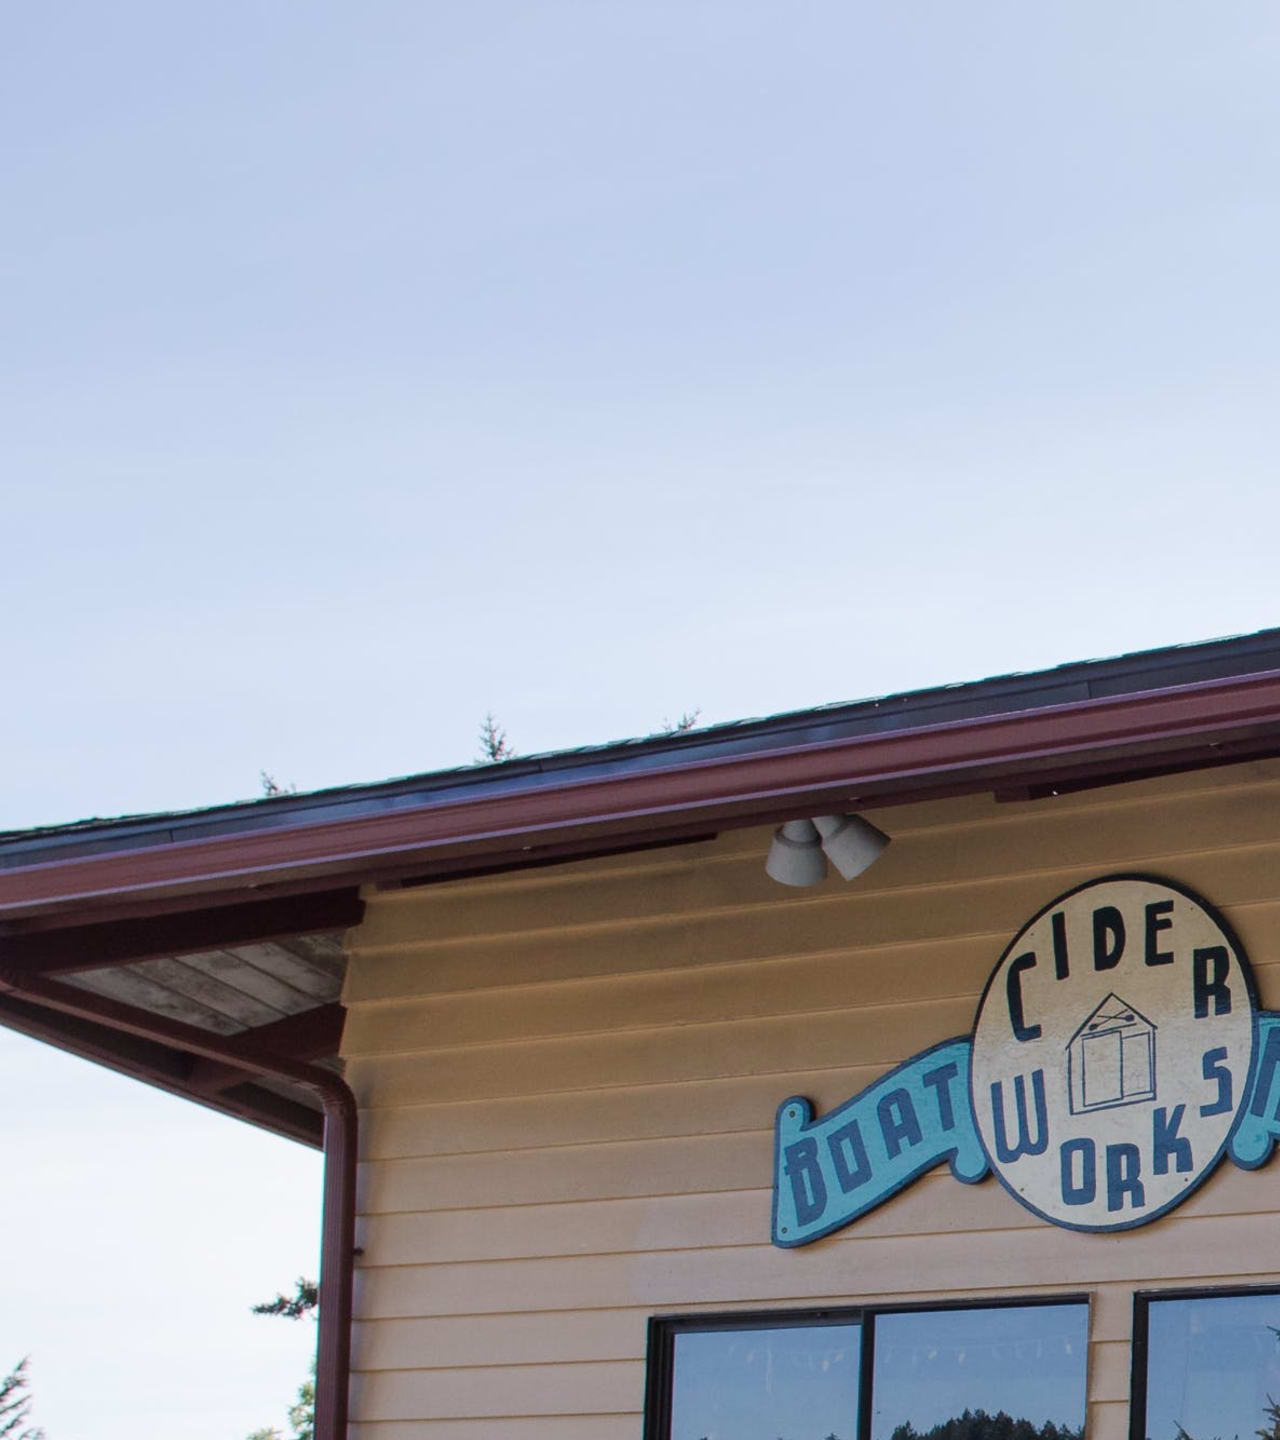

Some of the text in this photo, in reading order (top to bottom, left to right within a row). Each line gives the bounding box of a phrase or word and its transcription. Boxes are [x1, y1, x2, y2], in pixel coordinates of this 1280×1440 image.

[1006, 900, 1232, 1042] CIDER
[785, 1060, 960, 1227] BOAT
[989, 1046, 1235, 1212] WORKS
